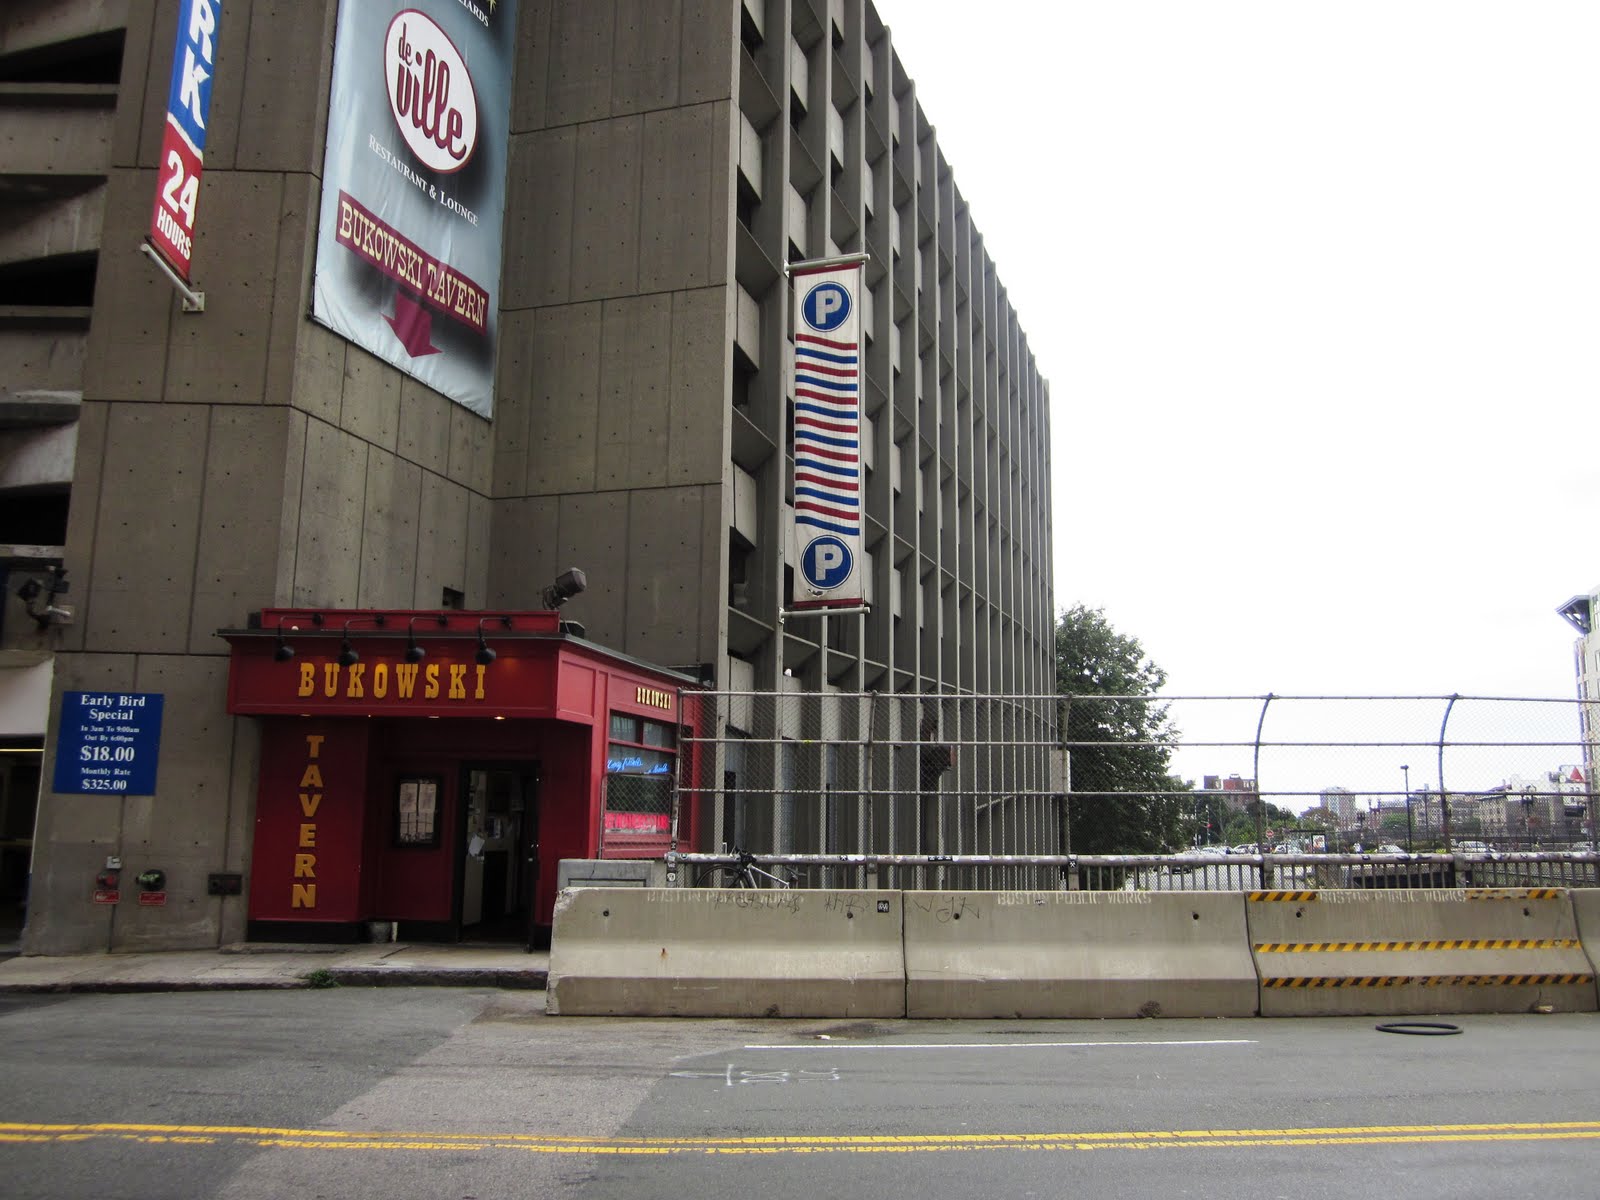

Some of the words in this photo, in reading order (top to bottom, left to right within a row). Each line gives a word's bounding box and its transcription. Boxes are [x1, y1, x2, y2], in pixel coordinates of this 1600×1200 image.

[398, 21, 412, 66] de
[180, 0, 220, 129] RK
[396, 48, 467, 161] ville
[162, 150, 200, 230] 24
[368, 133, 428, 193] RESTAURANT
[429, 184, 437, 200] &
[440, 190, 478, 227] LOUNGE
[156, 205, 192, 261] HOURS
[339, 200, 423, 290] BUKOWSKI
[427, 262, 486, 328] TAVERN
[815, 289, 843, 325] P
[815, 544, 844, 581] P
[298, 662, 486, 699] BUKOWSKI
[636, 686, 672, 710] BUKOWSKI
[80, 694, 115, 708] Early
[119, 695, 146, 707] Bird
[89, 708, 134, 722] Special
[80, 745, 135, 762] $18.00
[100, 734, 108, 742] By
[81, 767, 111, 776] Monthly
[114, 768, 131, 776] Rate
[81, 778, 127, 790] $325.00
[292, 735, 325, 908] TAVERN
[997, 891, 1045, 905] BOSTON
[1055, 892, 1101, 905] PUBLIC
[1107, 891, 1152, 904] WORKS
